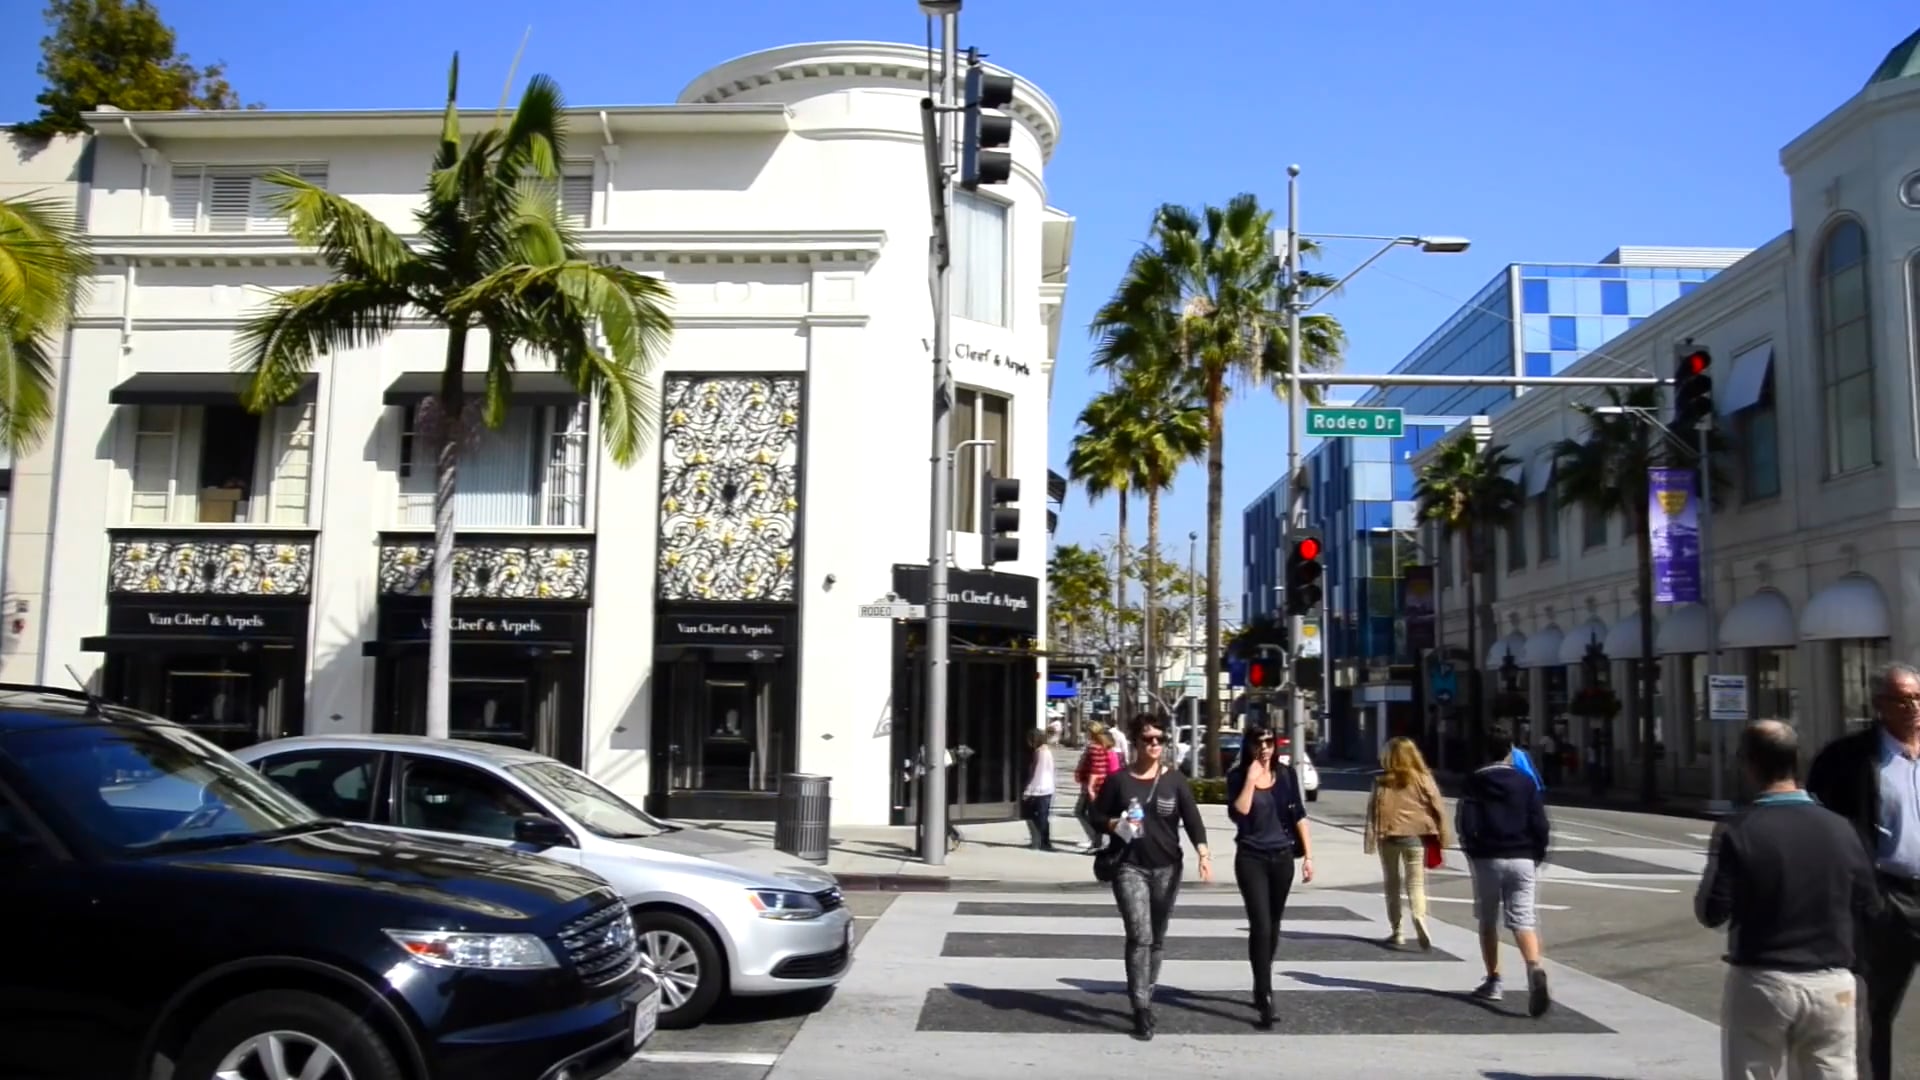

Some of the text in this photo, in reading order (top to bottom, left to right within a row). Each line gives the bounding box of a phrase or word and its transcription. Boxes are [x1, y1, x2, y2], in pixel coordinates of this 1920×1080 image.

[955, 343, 992, 362] Cleef
[1313, 414, 1395, 430] Rodeo Dr
[961, 589, 994, 604] Cleef
[1001, 595, 1028, 612] Arpels
[861, 606, 892, 617] RODEO
[148, 613, 265, 631] Van Cleef & Arpels
[448, 618, 542, 636] Cleef & Arpels
[677, 623, 774, 638] Van Cleef & Arpels
